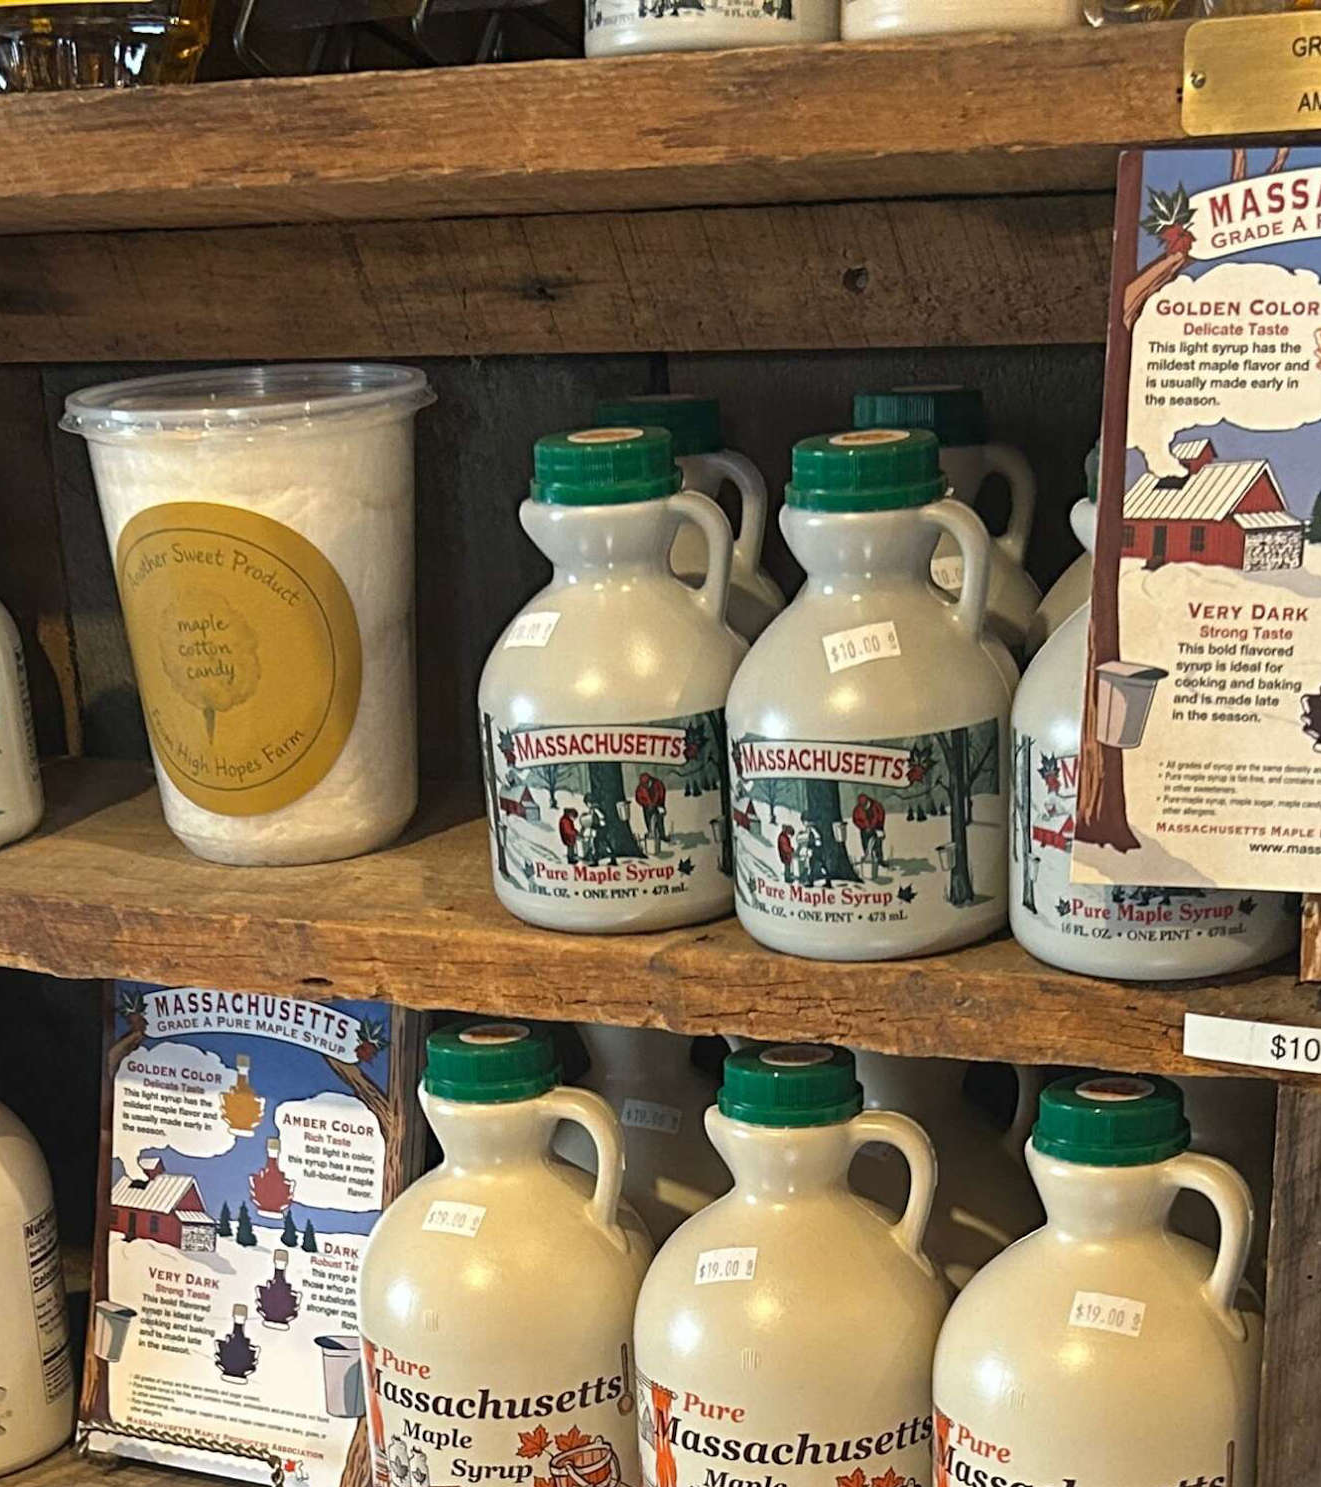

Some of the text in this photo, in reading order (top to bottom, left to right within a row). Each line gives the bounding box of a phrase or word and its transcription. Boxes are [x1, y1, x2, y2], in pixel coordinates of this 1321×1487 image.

[1211, 221, 1284, 248] GRADE
[1292, 216, 1307, 232] A
[1157, 300, 1320, 315] GOLDEN COLOR
[1184, 323, 1289, 335] Delicate Taste
[1149, 342, 1301, 356] This light syrup has the
[1147, 360, 1310, 373] mildest maple flavor and
[1146, 377, 1298, 391] is usually made early in
[1146, 395, 1220, 406] the season.
[128, 543, 300, 606] Another Sweet Product
[1188, 603, 1308, 621] VERY DARK
[178, 615, 228, 640] maple
[1200, 626, 1293, 641] Strong Taste
[178, 642, 231, 657] cotton
[1178, 643, 1293, 656] This bold flavored
[187, 664, 235, 684] candy
[1176, 662, 1283, 673] syrup is ideal for
[1175, 678, 1301, 692] cooking and baking
[1174, 694, 1279, 706] and is made late
[1172, 710, 1261, 722] in the season.
[178, 729, 305, 782] High Hopes Farm
[1156, 822, 1266, 836] MASSACHUSETTS
[1271, 826, 1314, 838] MAPLE
